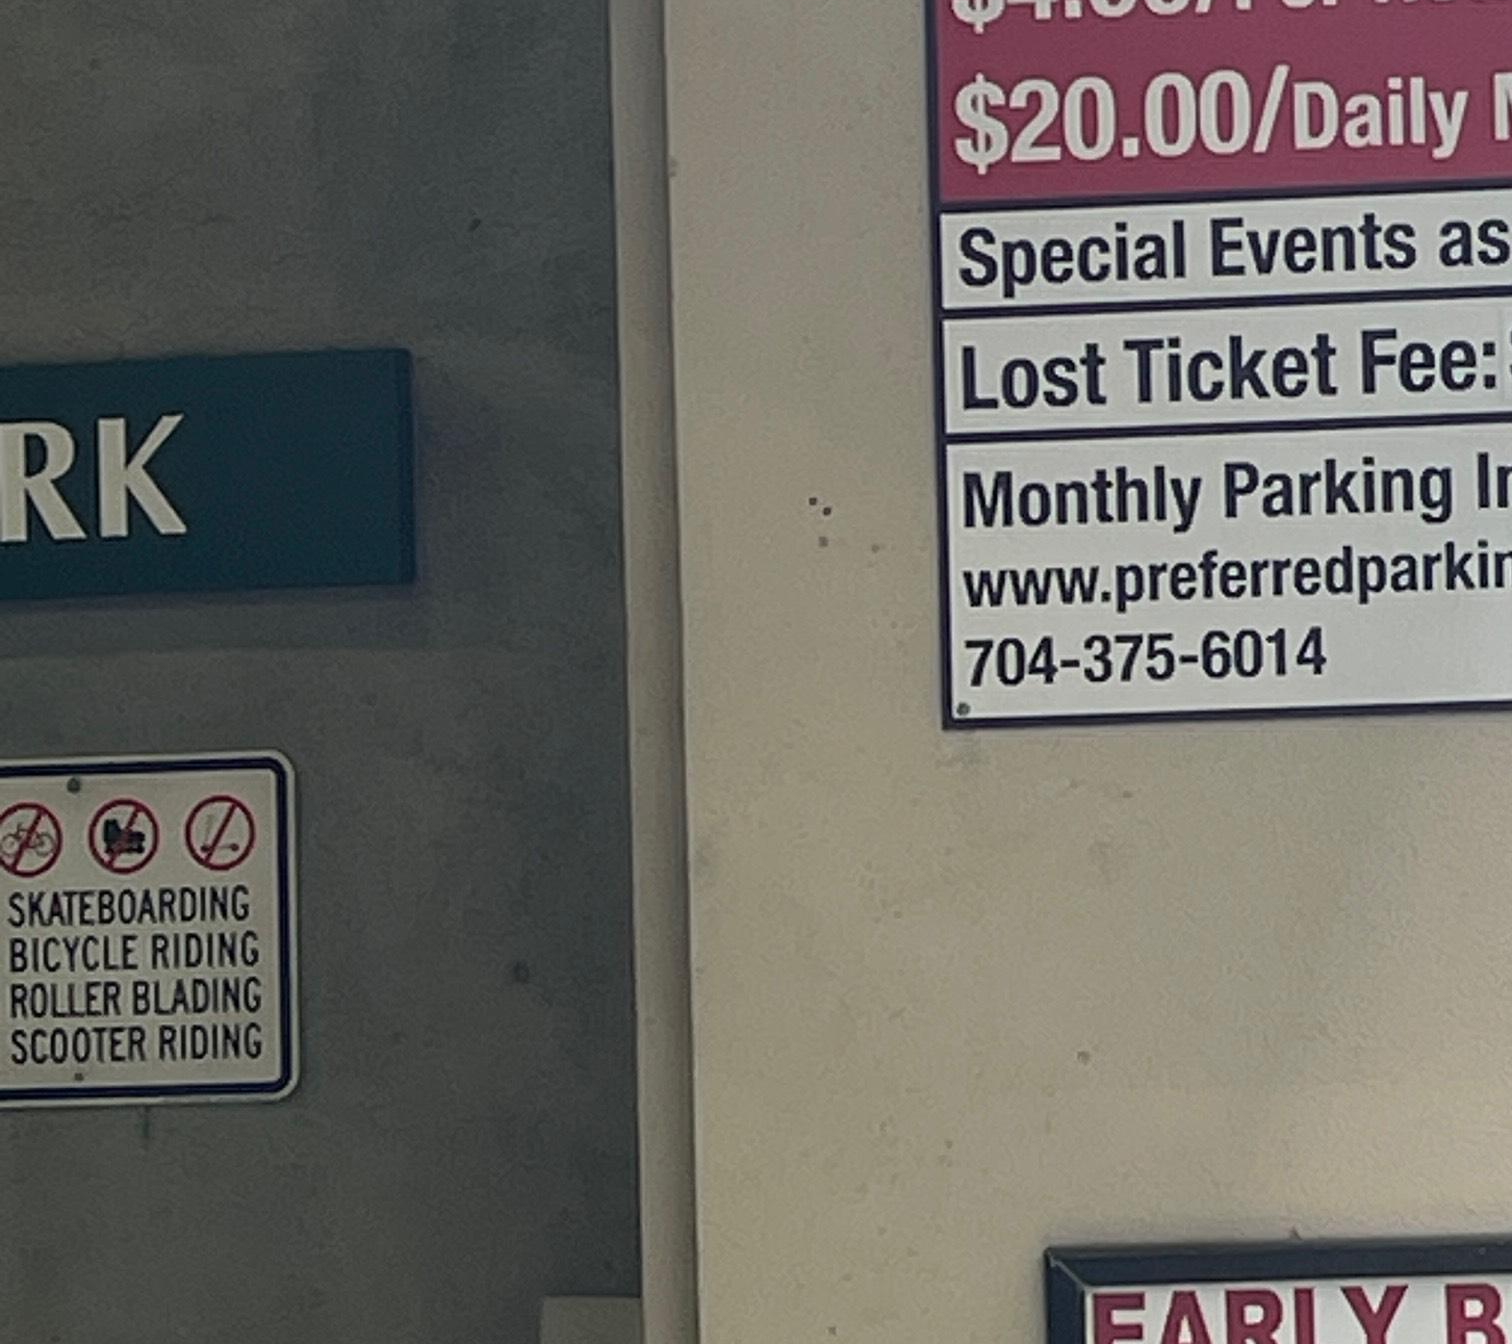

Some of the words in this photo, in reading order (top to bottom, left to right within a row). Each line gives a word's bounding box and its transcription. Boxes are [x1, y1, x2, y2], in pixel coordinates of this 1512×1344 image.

[954, 65, 1468, 175] $20.00/Daily
[958, 220, 1185, 298] Special
[1210, 211, 1417, 276] Events
[1439, 214, 1510, 265] as
[962, 343, 1106, 411] Lost
[1124, 332, 1336, 403] Ticket
[1362, 328, 1497, 394] Fee:
[963, 465, 1201, 534] Monthly
[1224, 457, 1453, 523] Parking
[965, 628, 1326, 688] 704-375-6014
[7, 884, 249, 927] SKATEBOARDING
[10, 934, 138, 973] BICYCLE
[152, 930, 259, 970] RIDING
[10, 981, 121, 1019] ROLLER
[132, 976, 262, 1016] BLADING
[11, 1025, 146, 1065] SCOOTER
[159, 1022, 262, 1061] RIDING
